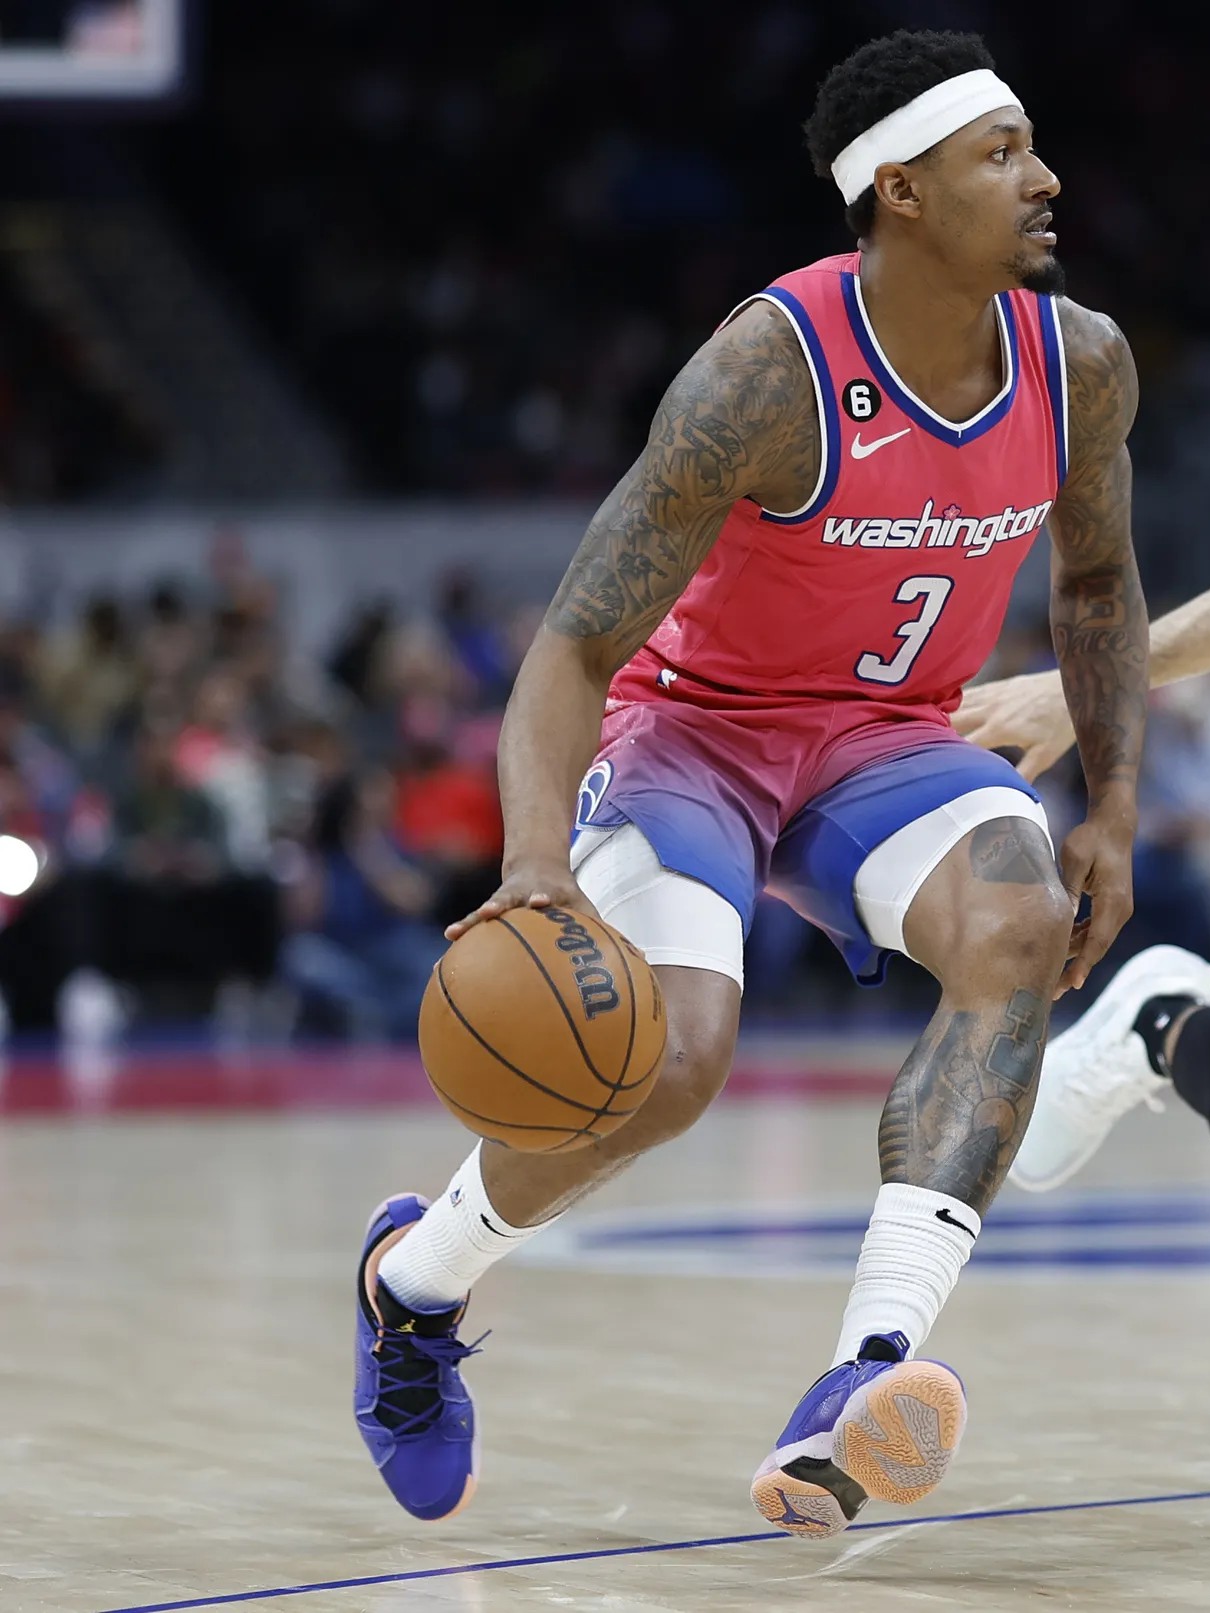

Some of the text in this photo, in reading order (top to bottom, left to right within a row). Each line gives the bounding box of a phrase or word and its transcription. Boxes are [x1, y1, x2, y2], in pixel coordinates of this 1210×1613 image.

[850, 385, 872, 417] 6
[822, 496, 1053, 558] washington
[854, 574, 956, 687] 3
